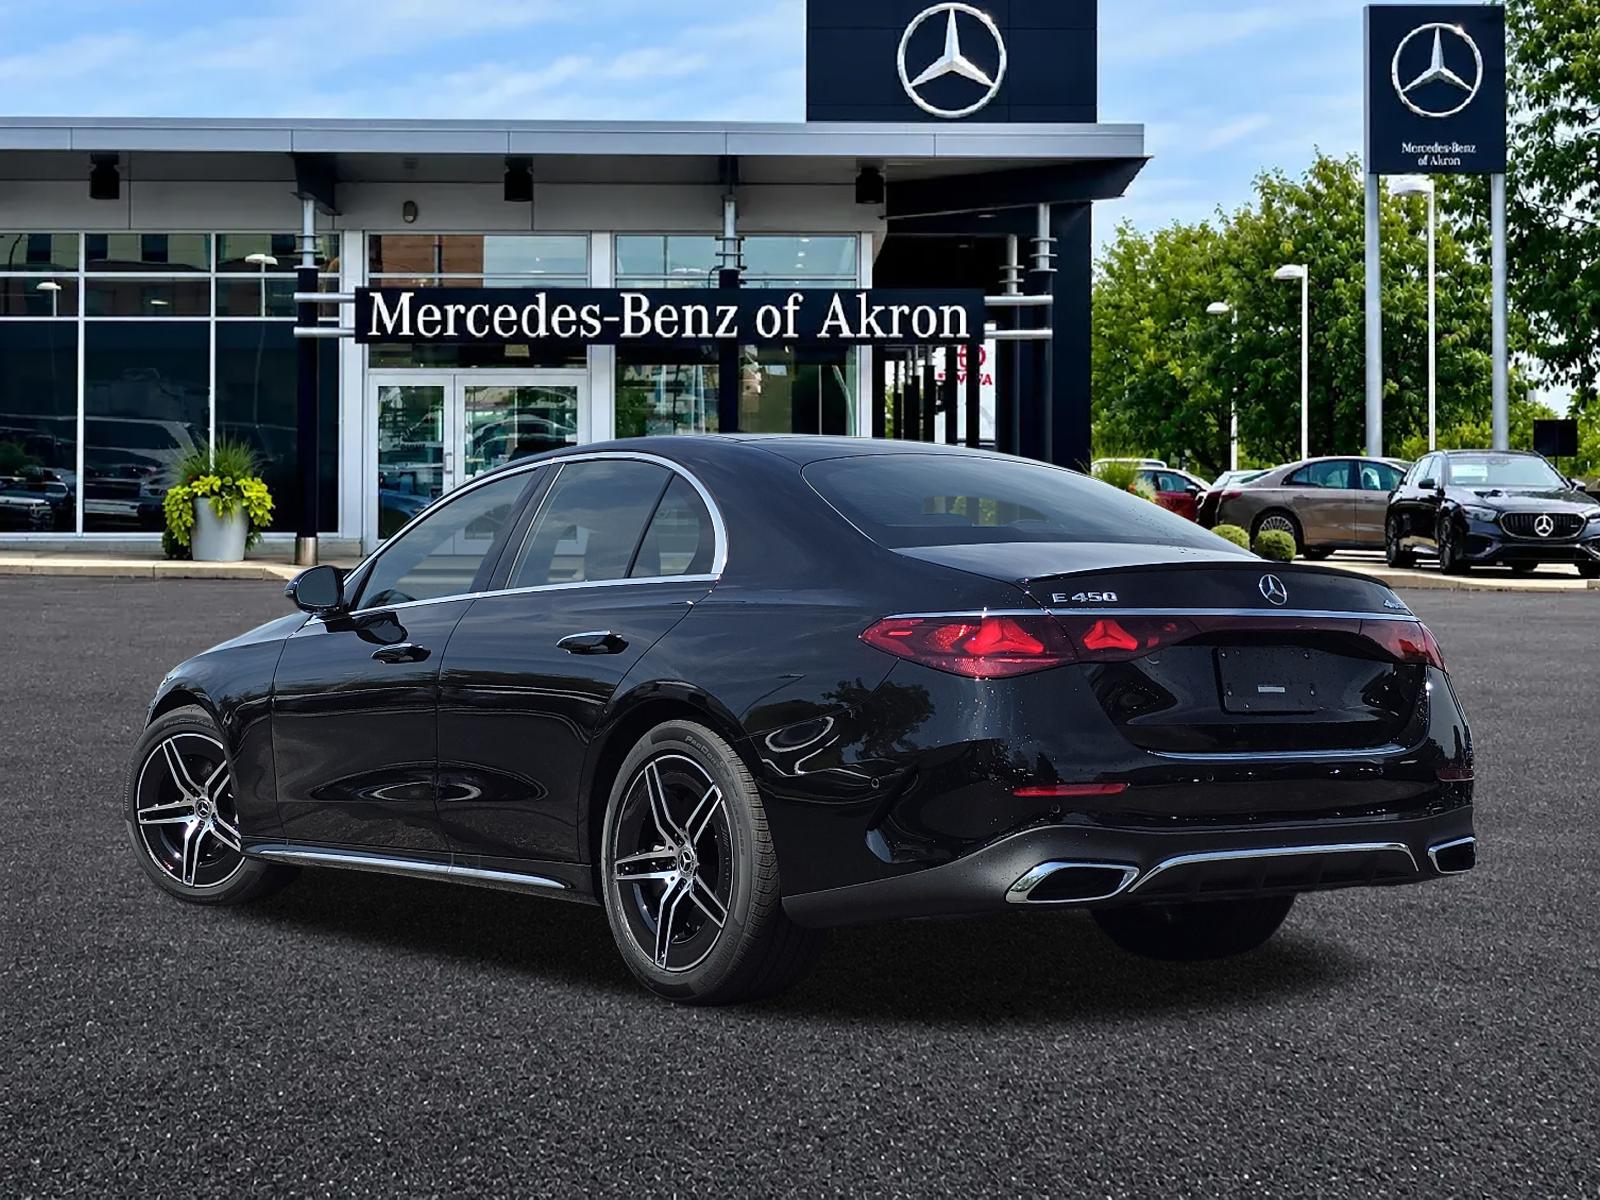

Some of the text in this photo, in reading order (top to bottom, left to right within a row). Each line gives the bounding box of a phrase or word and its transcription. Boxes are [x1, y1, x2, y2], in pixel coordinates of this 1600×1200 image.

[1401, 142, 1476, 153] Mercedes-Benz
[1418, 155, 1461, 166] of Akron
[367, 291, 971, 339] Mercedes-Benz of Akron
[1052, 591, 1119, 603] E 450
